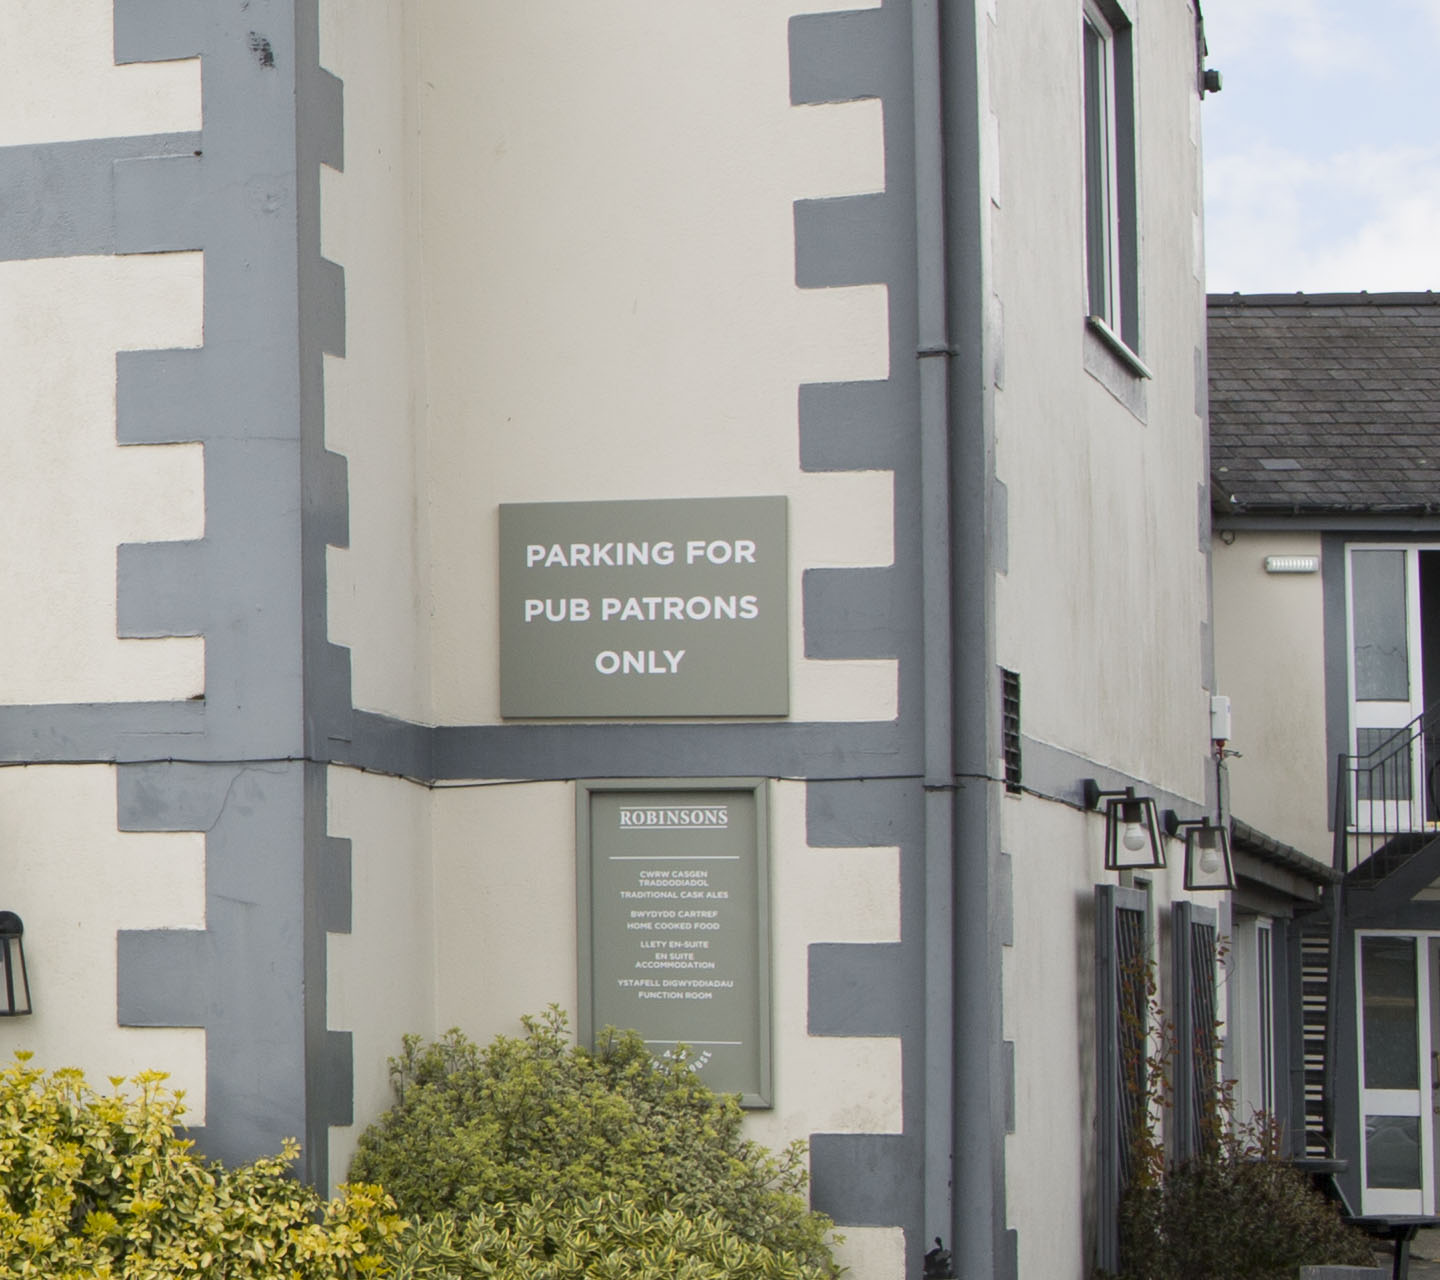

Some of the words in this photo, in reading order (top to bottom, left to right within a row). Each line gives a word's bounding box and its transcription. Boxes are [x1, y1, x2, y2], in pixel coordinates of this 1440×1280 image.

[526, 541, 674, 567] PARKING
[687, 540, 756, 564] FOR
[525, 598, 591, 622] PUB
[602, 595, 759, 621] PATRONS
[595, 650, 686, 674] ONLY
[620, 809, 728, 825] ROBINSONS
[620, 891, 678, 899] TRADITIONAL
[680, 891, 704, 899] CASK
[706, 891, 728, 899] ALES
[678, 910, 718, 918] CARTREF
[627, 922, 653, 930] HOME
[654, 922, 692, 930] COOKED
[693, 922, 720, 930] FOOD
[655, 952, 667, 960] EN
[669, 952, 694, 960] SUITE
[635, 961, 715, 969] ACCOMMODATION
[617, 979, 660, 987] YSTAFELL
[638, 991, 684, 999] FUNCTION
